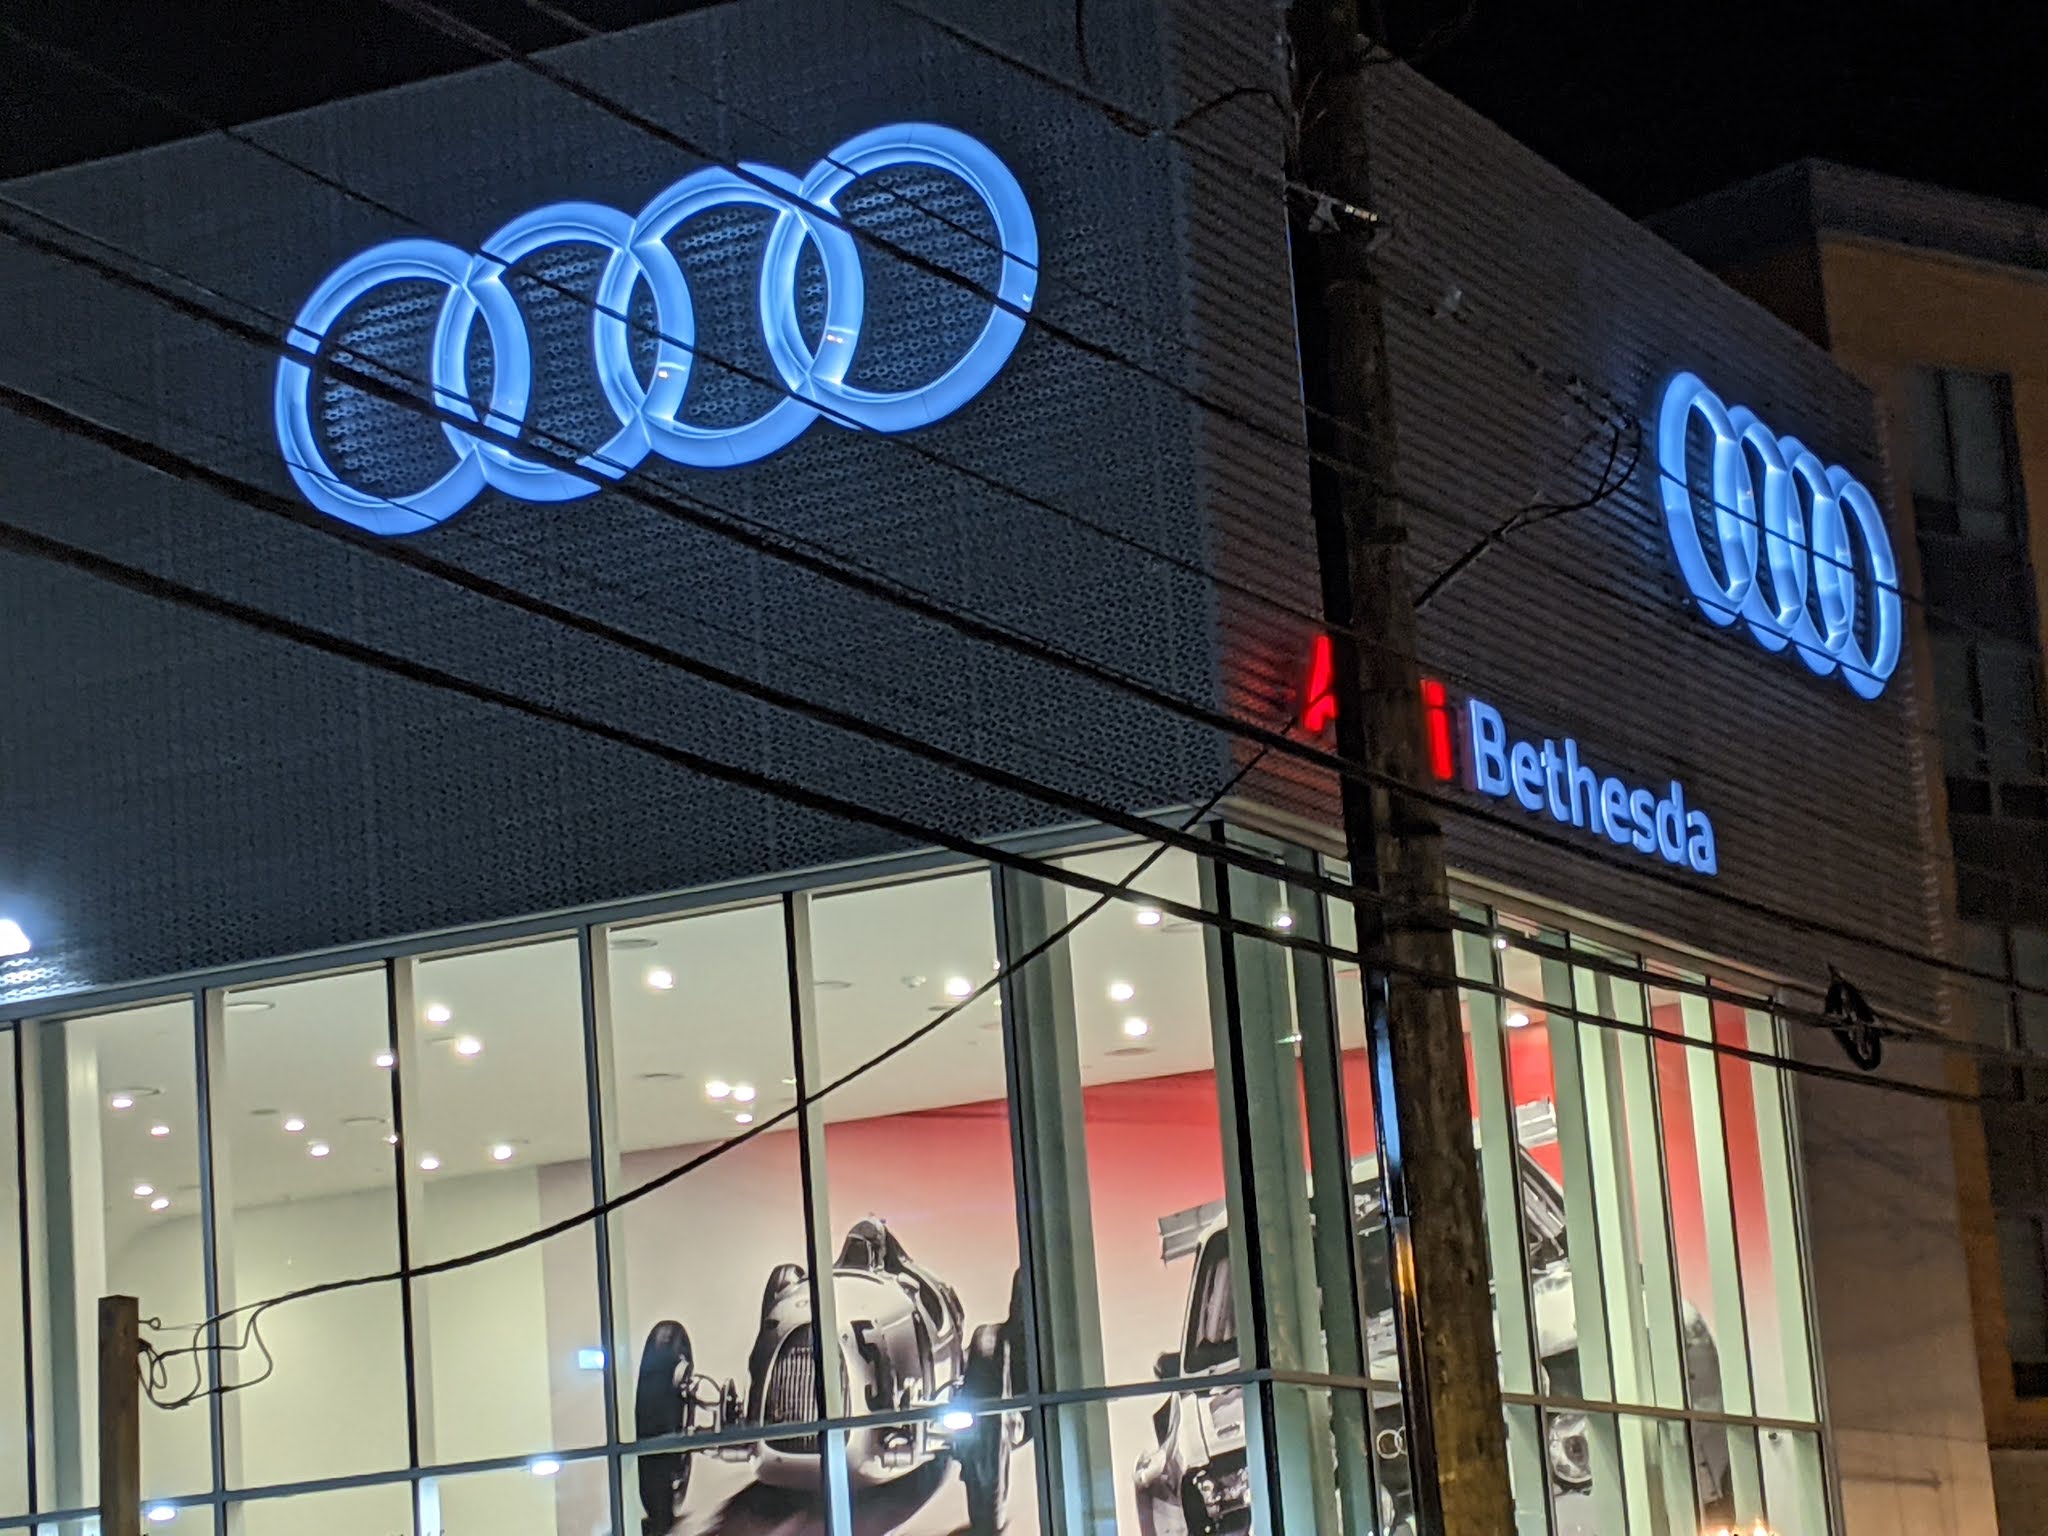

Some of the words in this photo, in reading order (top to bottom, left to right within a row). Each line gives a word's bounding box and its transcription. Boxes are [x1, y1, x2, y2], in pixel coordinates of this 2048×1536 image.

[1304, 634, 1453, 781] Ai
[1469, 698, 1718, 876] Bethesda
[850, 1319, 894, 1412] 5
